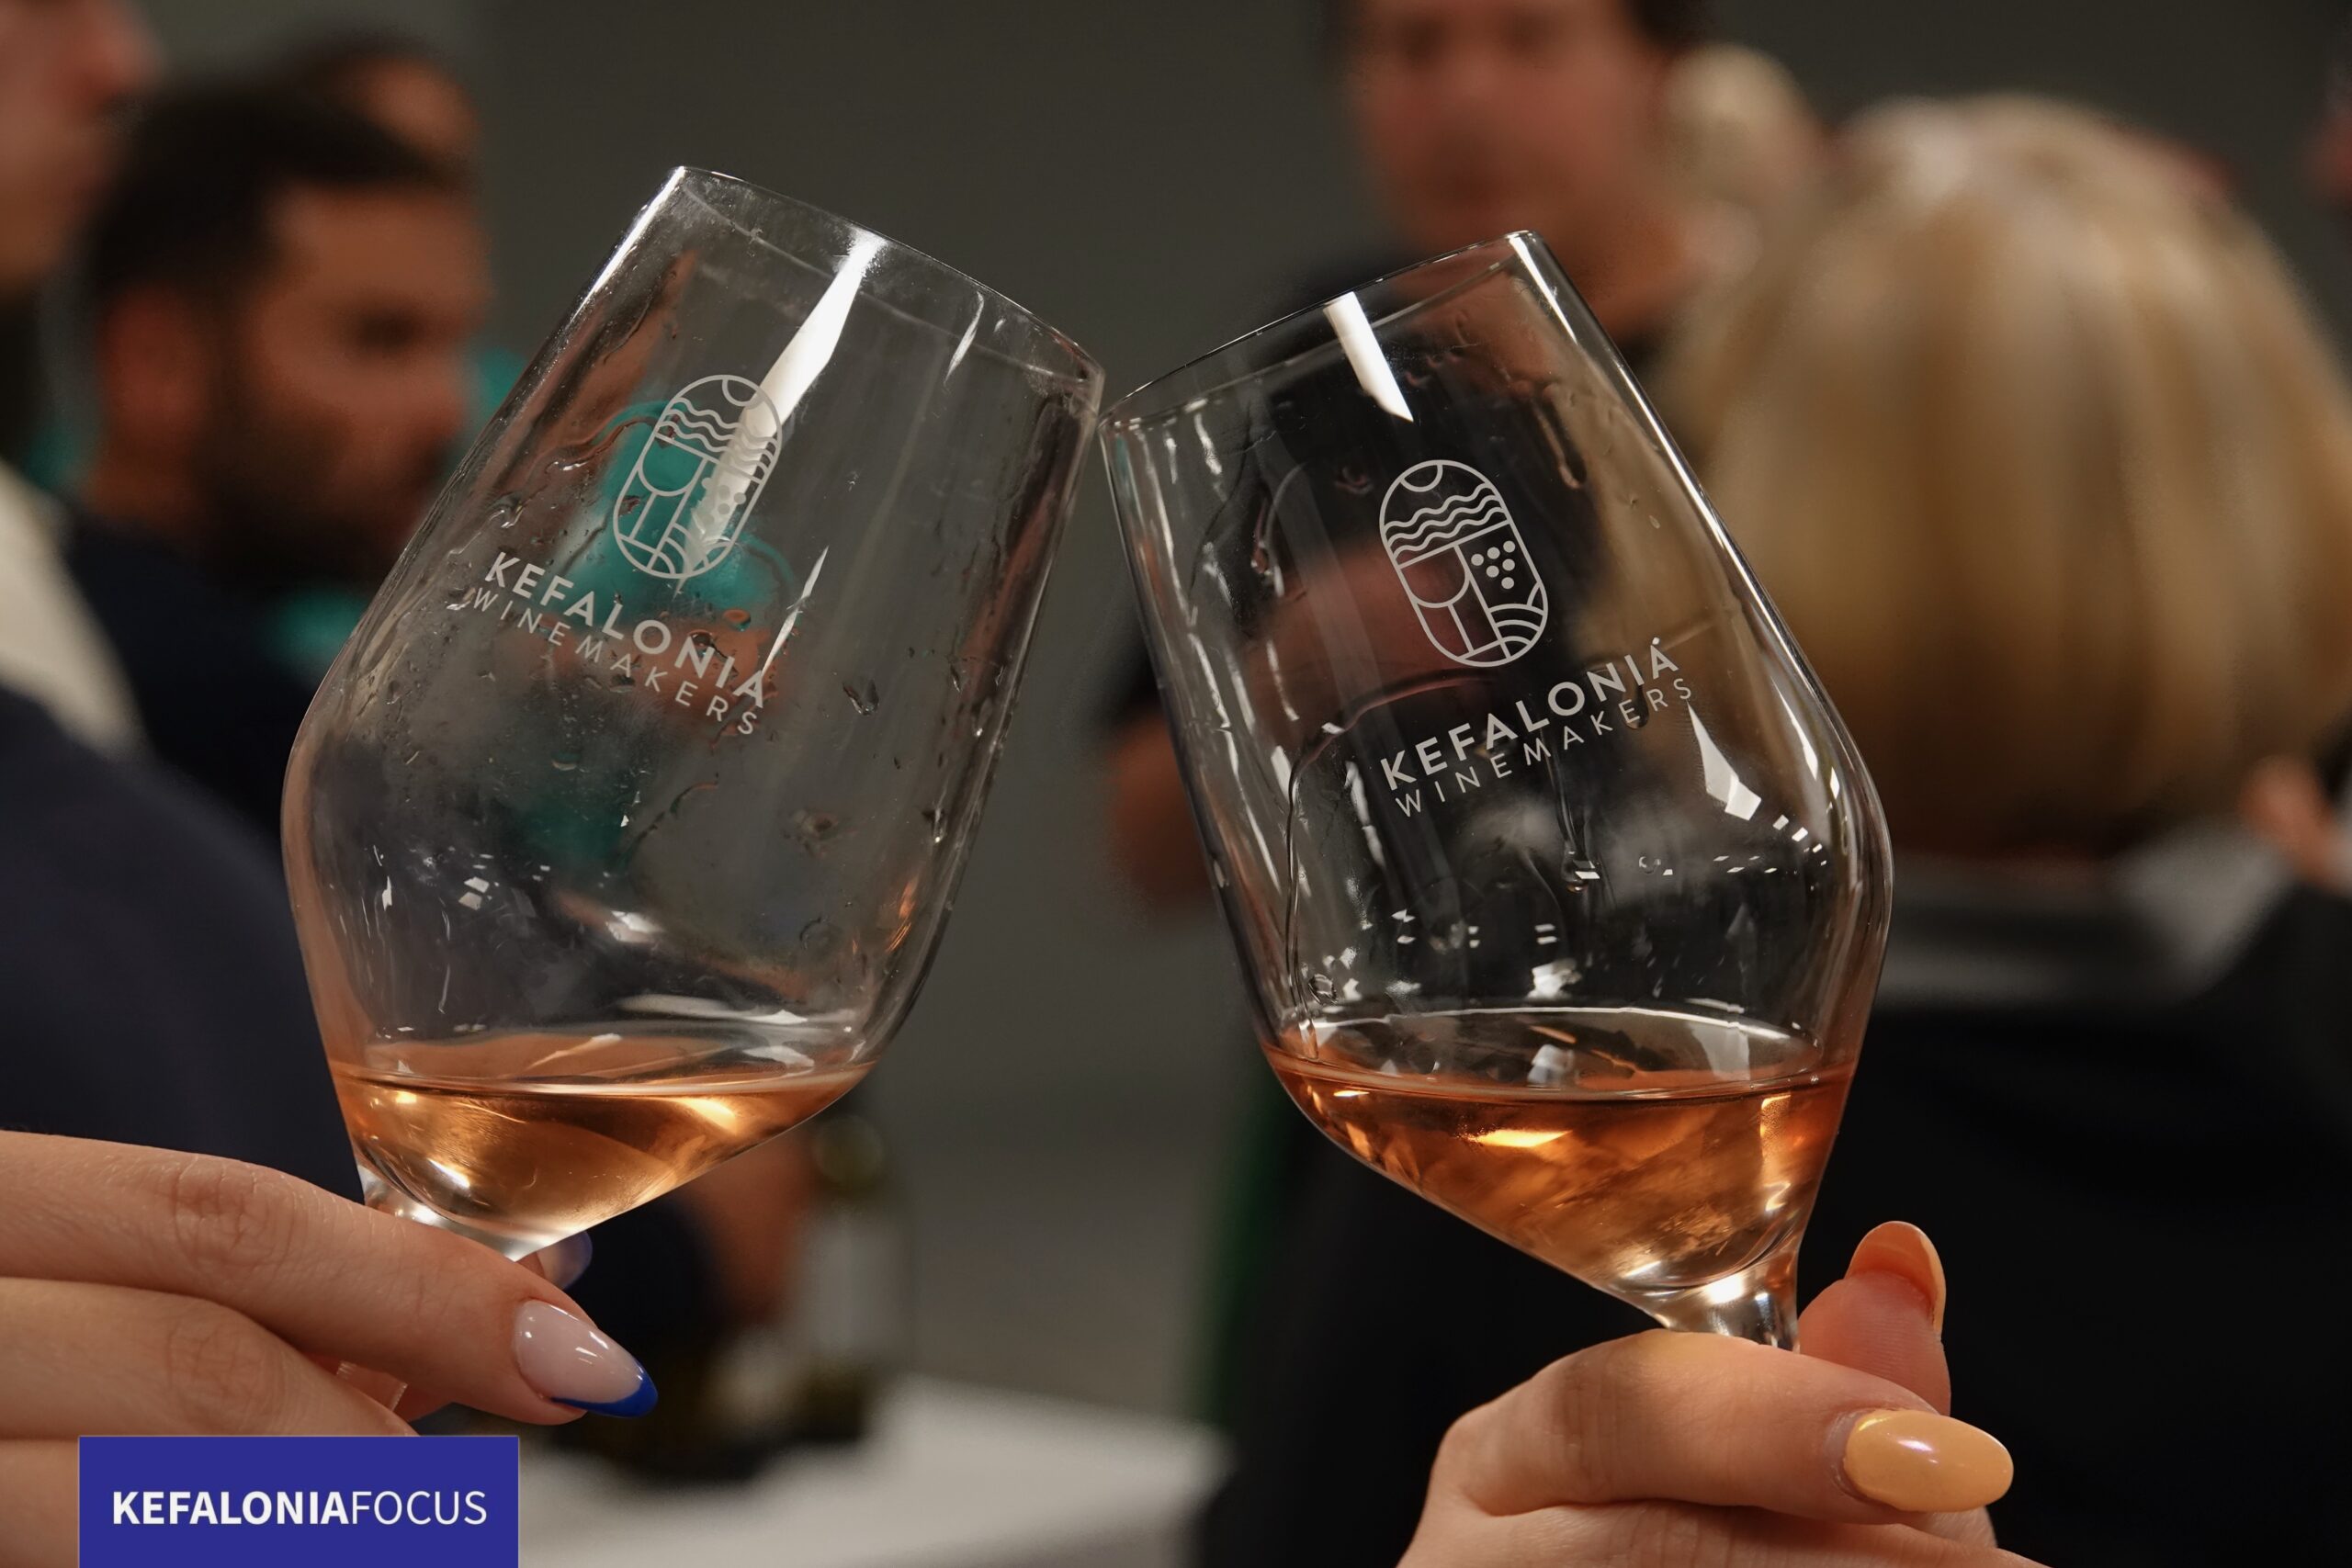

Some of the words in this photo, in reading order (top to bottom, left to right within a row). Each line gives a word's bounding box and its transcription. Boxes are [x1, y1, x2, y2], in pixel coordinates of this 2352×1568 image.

[473, 587, 758, 736] WINEMAKERS
[484, 551, 764, 708] KEFALONIA
[1380, 644, 1679, 791] KEFALONIA
[1395, 677, 1692, 818] WINEMAKERS
